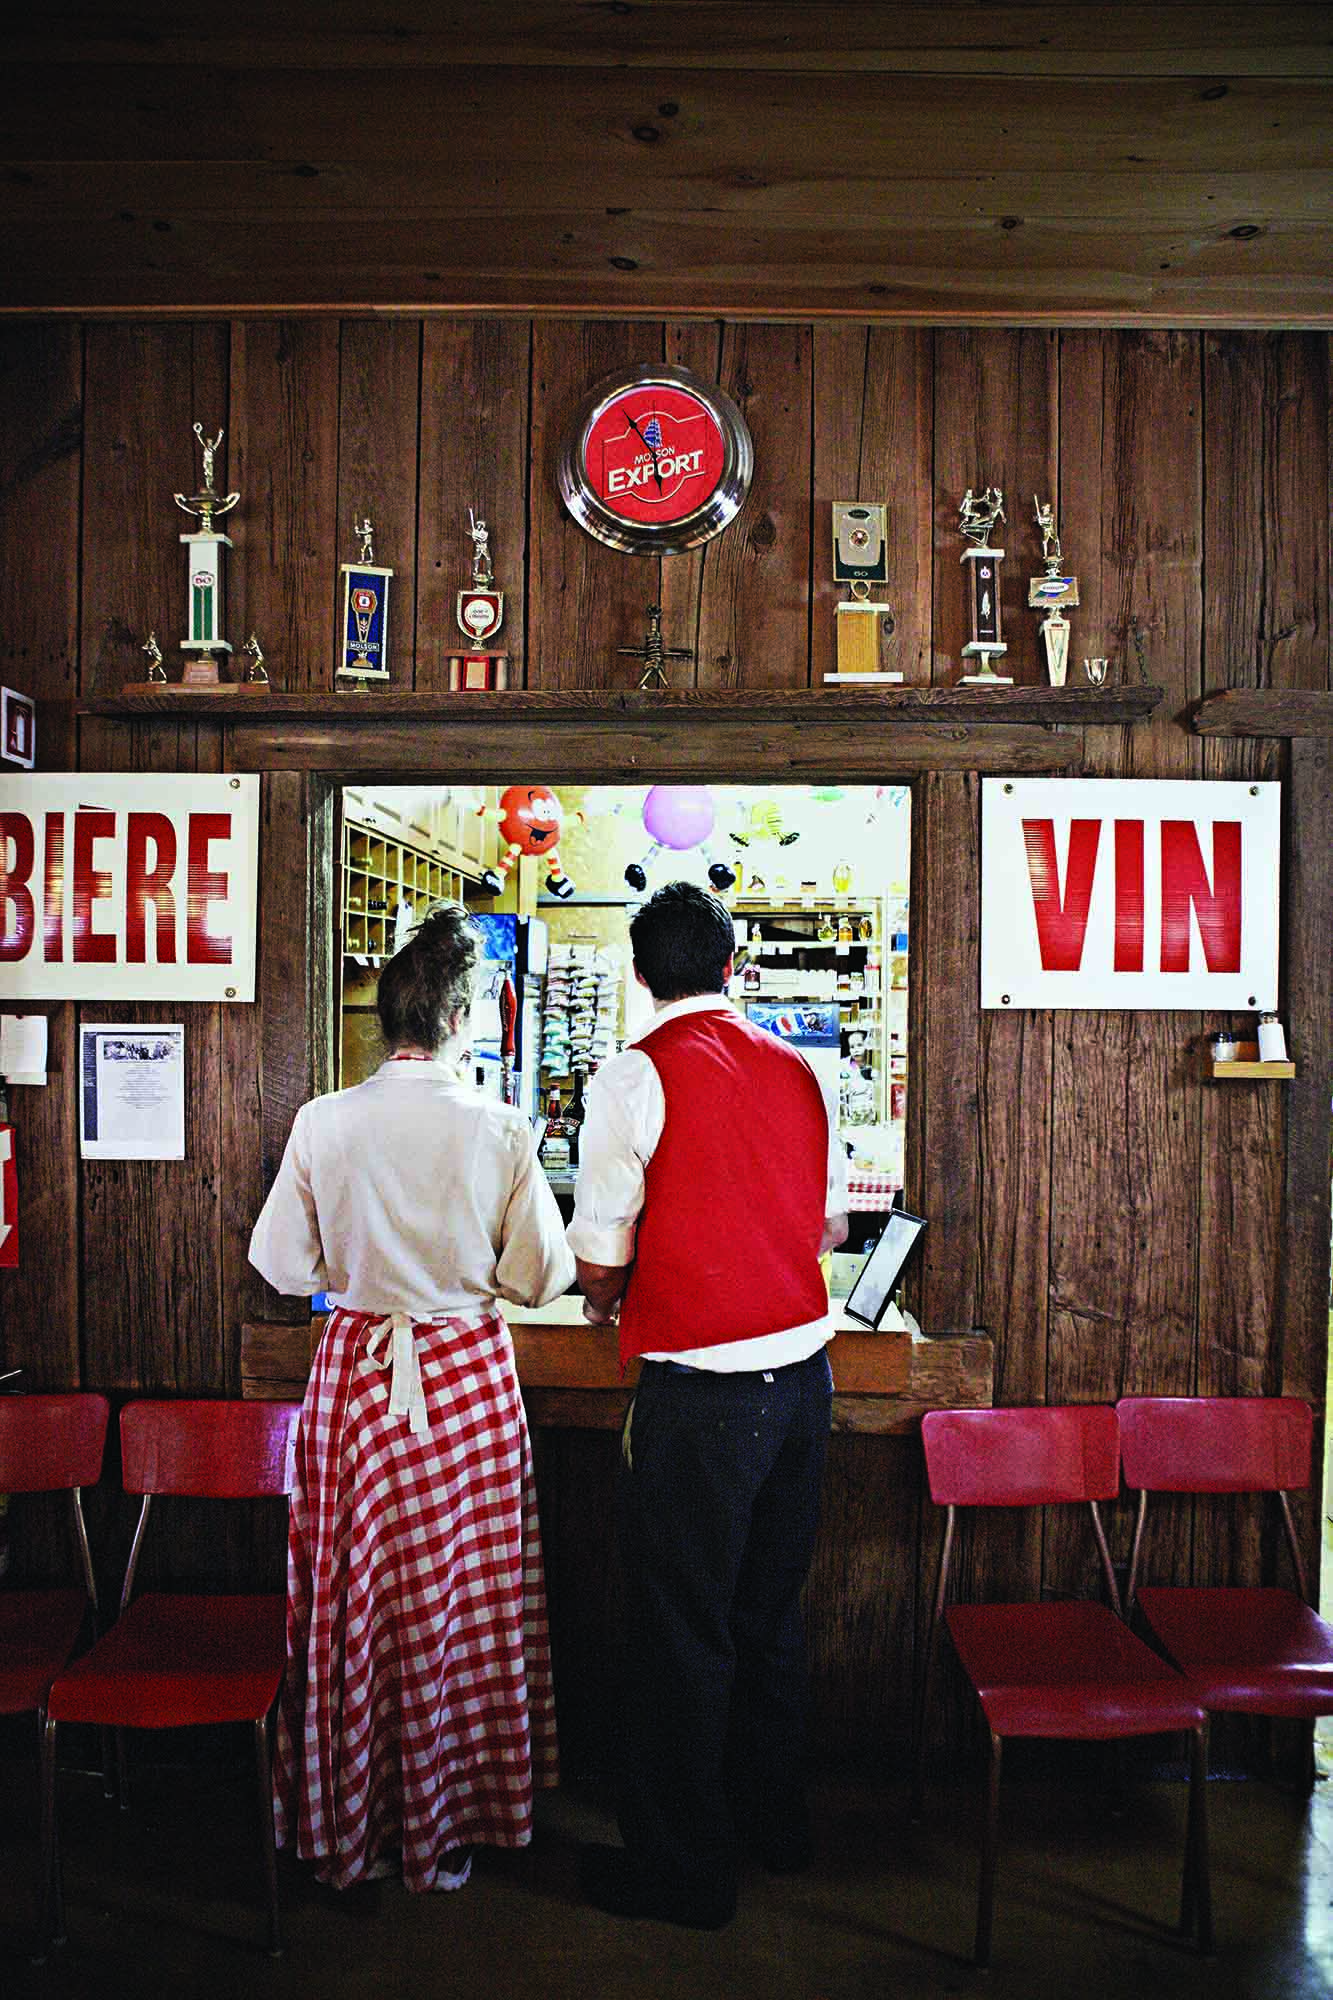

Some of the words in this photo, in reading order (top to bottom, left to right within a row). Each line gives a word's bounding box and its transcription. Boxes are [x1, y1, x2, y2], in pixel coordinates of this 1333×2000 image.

[608, 450, 704, 493] EXPORT
[0, 803, 233, 965] BIÈRE
[1021, 818, 1242, 973] VIN
